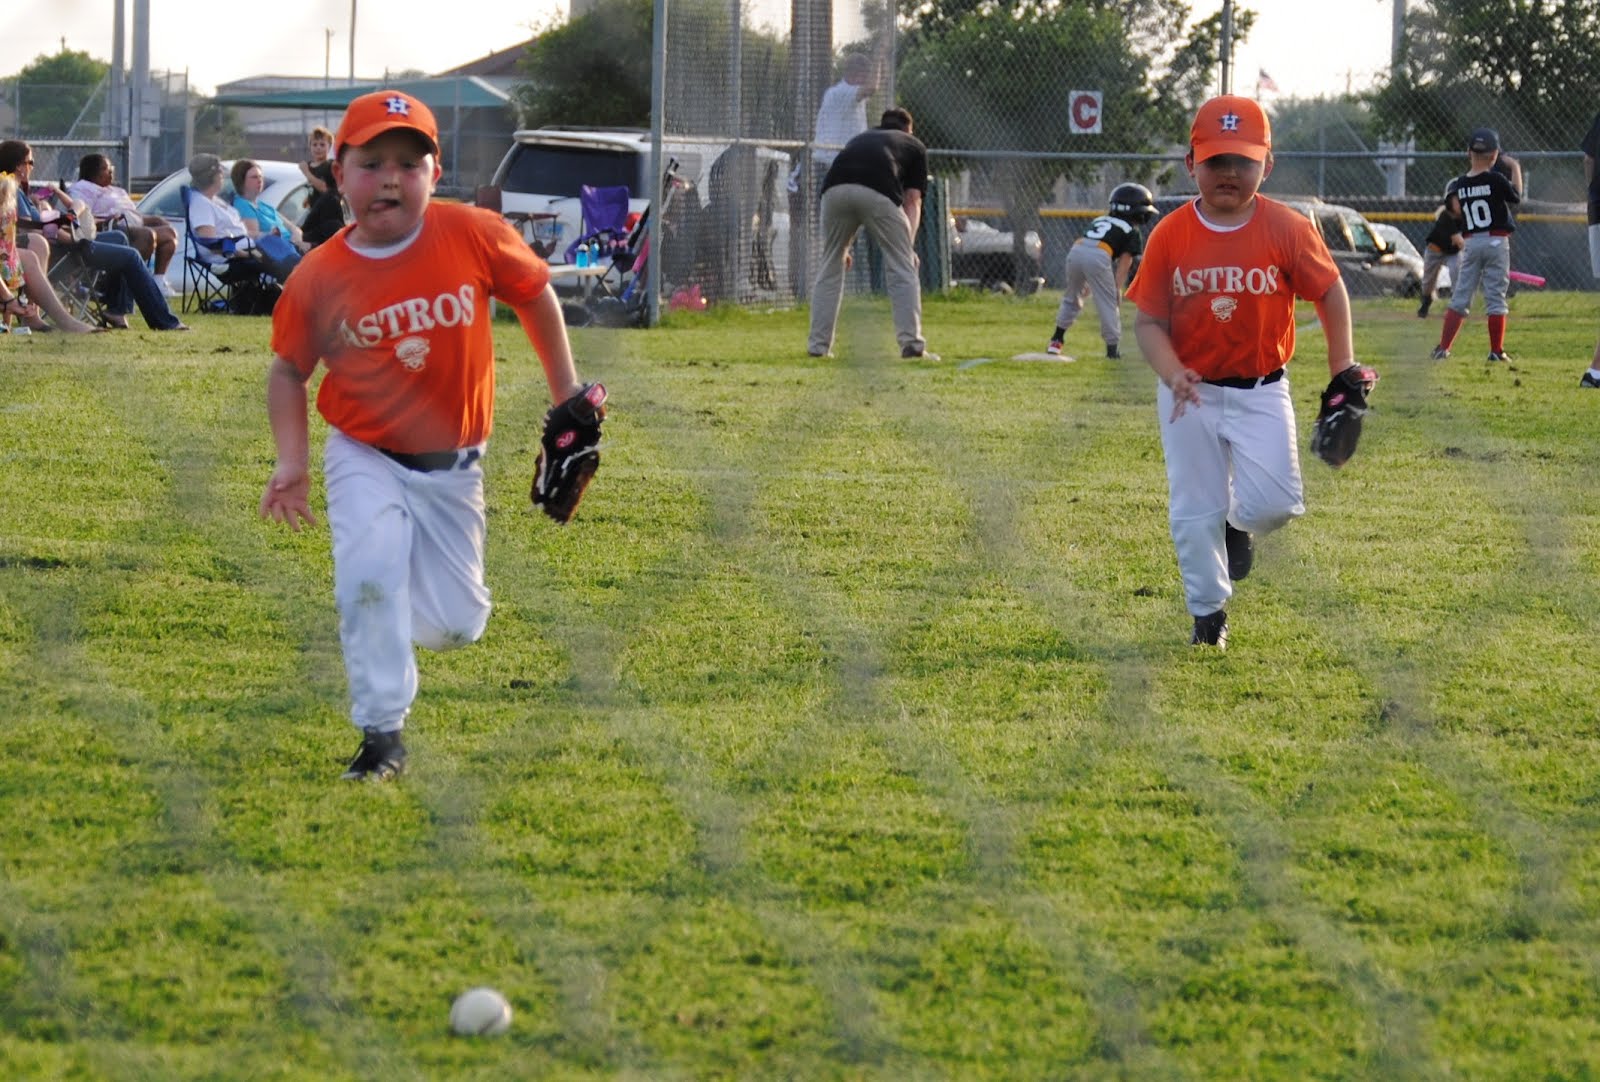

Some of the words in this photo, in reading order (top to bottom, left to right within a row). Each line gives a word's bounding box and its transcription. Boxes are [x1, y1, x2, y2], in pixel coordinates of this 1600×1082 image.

[386, 98, 409, 115] H
[1072, 95, 1098, 129] C
[1222, 114, 1239, 130] H
[1086, 221, 1112, 239] 3
[1462, 199, 1492, 231] 10
[1173, 264, 1280, 297] ASTROS
[339, 284, 475, 348] ASTROS
